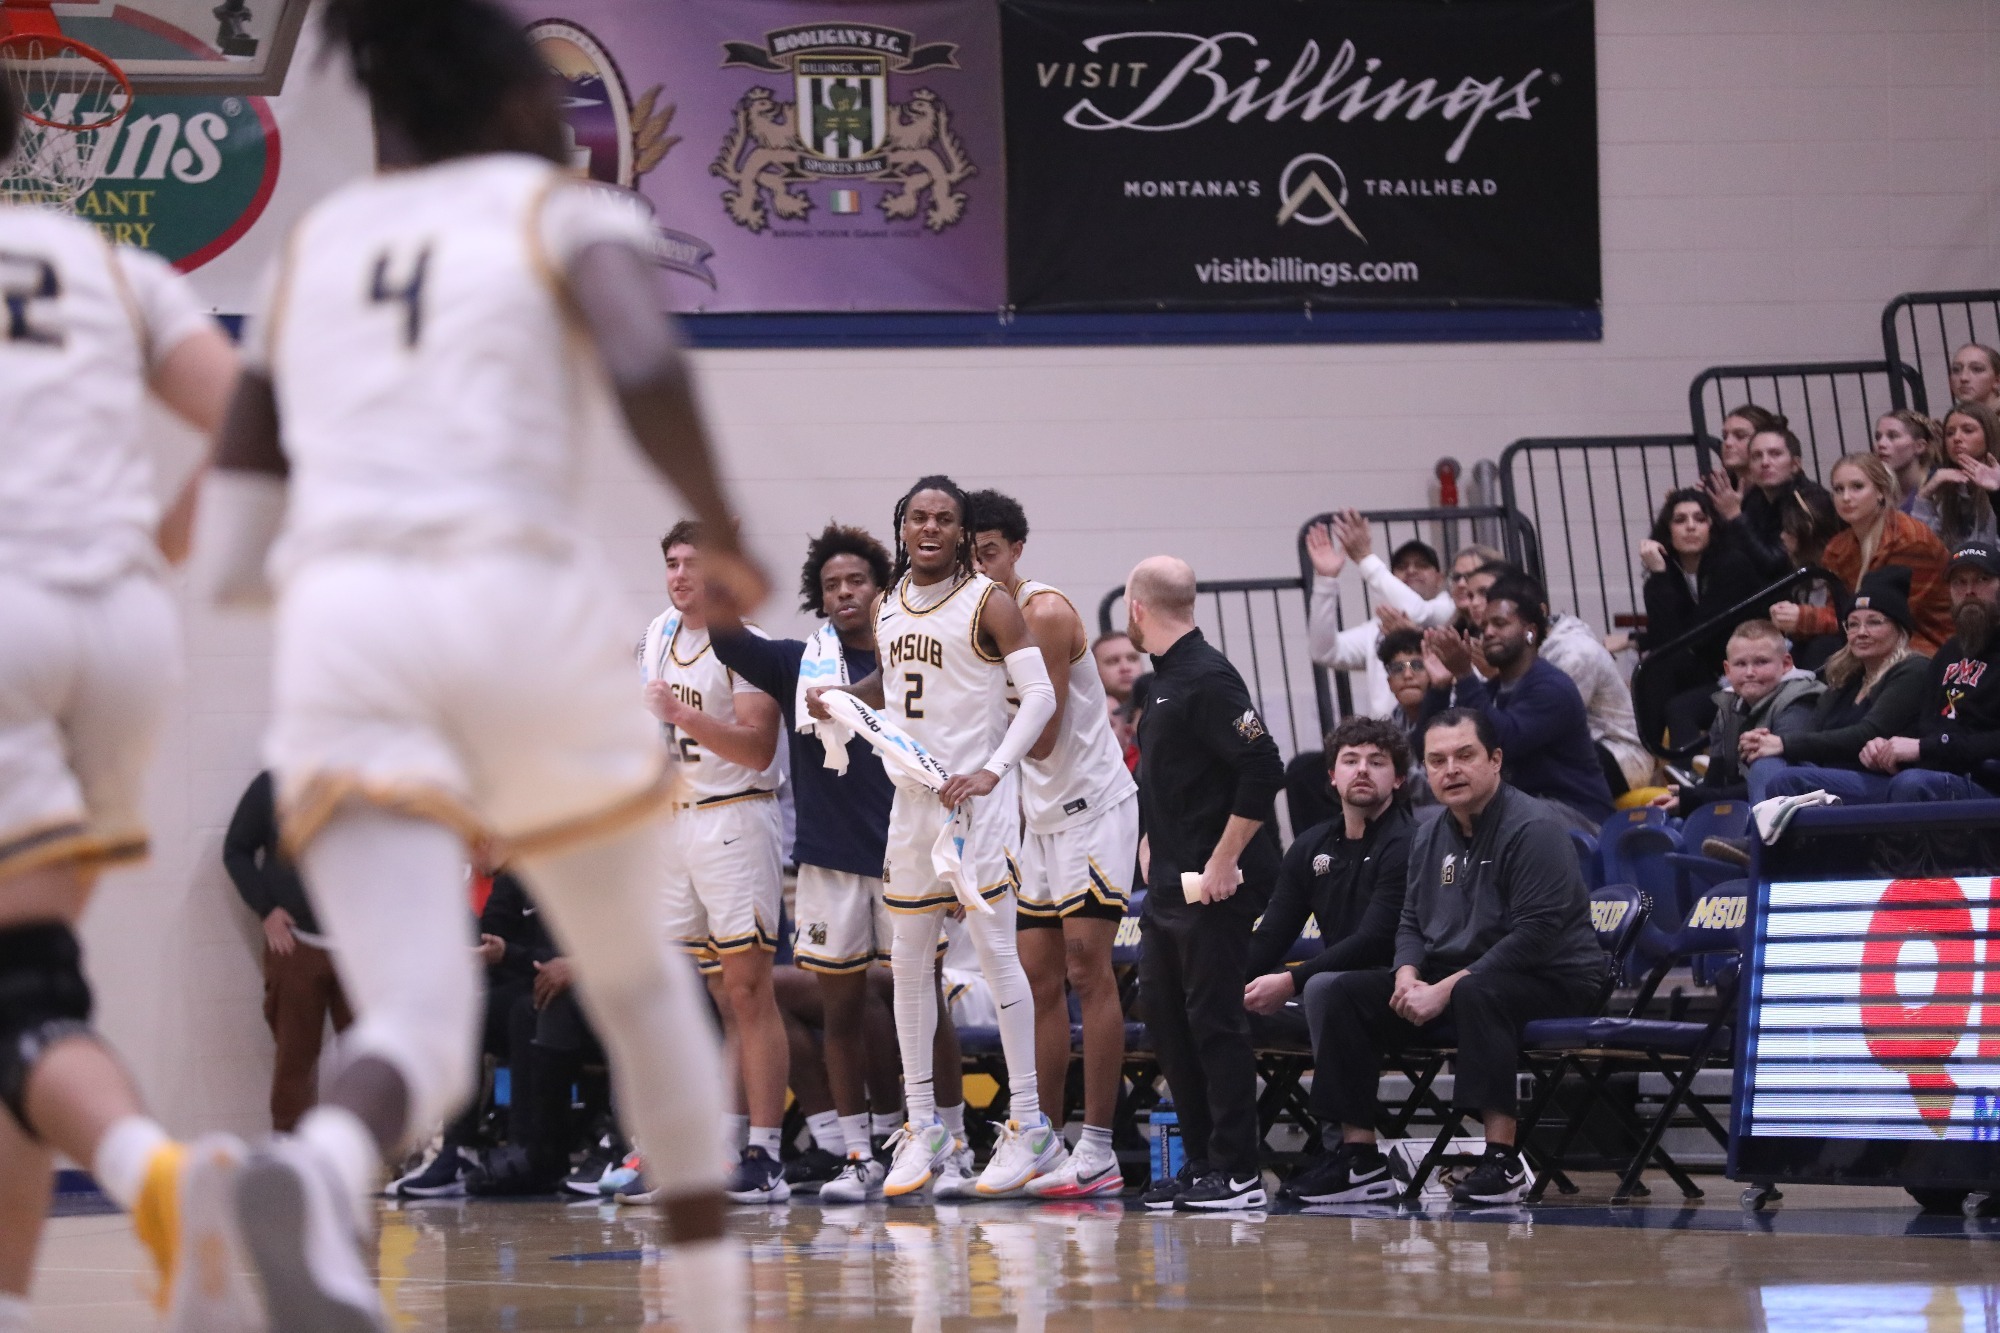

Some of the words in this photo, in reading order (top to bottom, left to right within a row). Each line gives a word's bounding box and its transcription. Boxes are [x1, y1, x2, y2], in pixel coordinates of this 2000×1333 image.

[1037, 62, 1148, 88] VISIT
[1064, 31, 1542, 163] Billings
[1124, 179, 1261, 197] MONTANA'S
[1364, 179, 1498, 196] TRAILHEAD
[1195, 258, 1418, 286] visitbillings.com
[369, 238, 434, 348] 4
[889, 633, 943, 670] MSUB
[904, 673, 925, 719] 2
